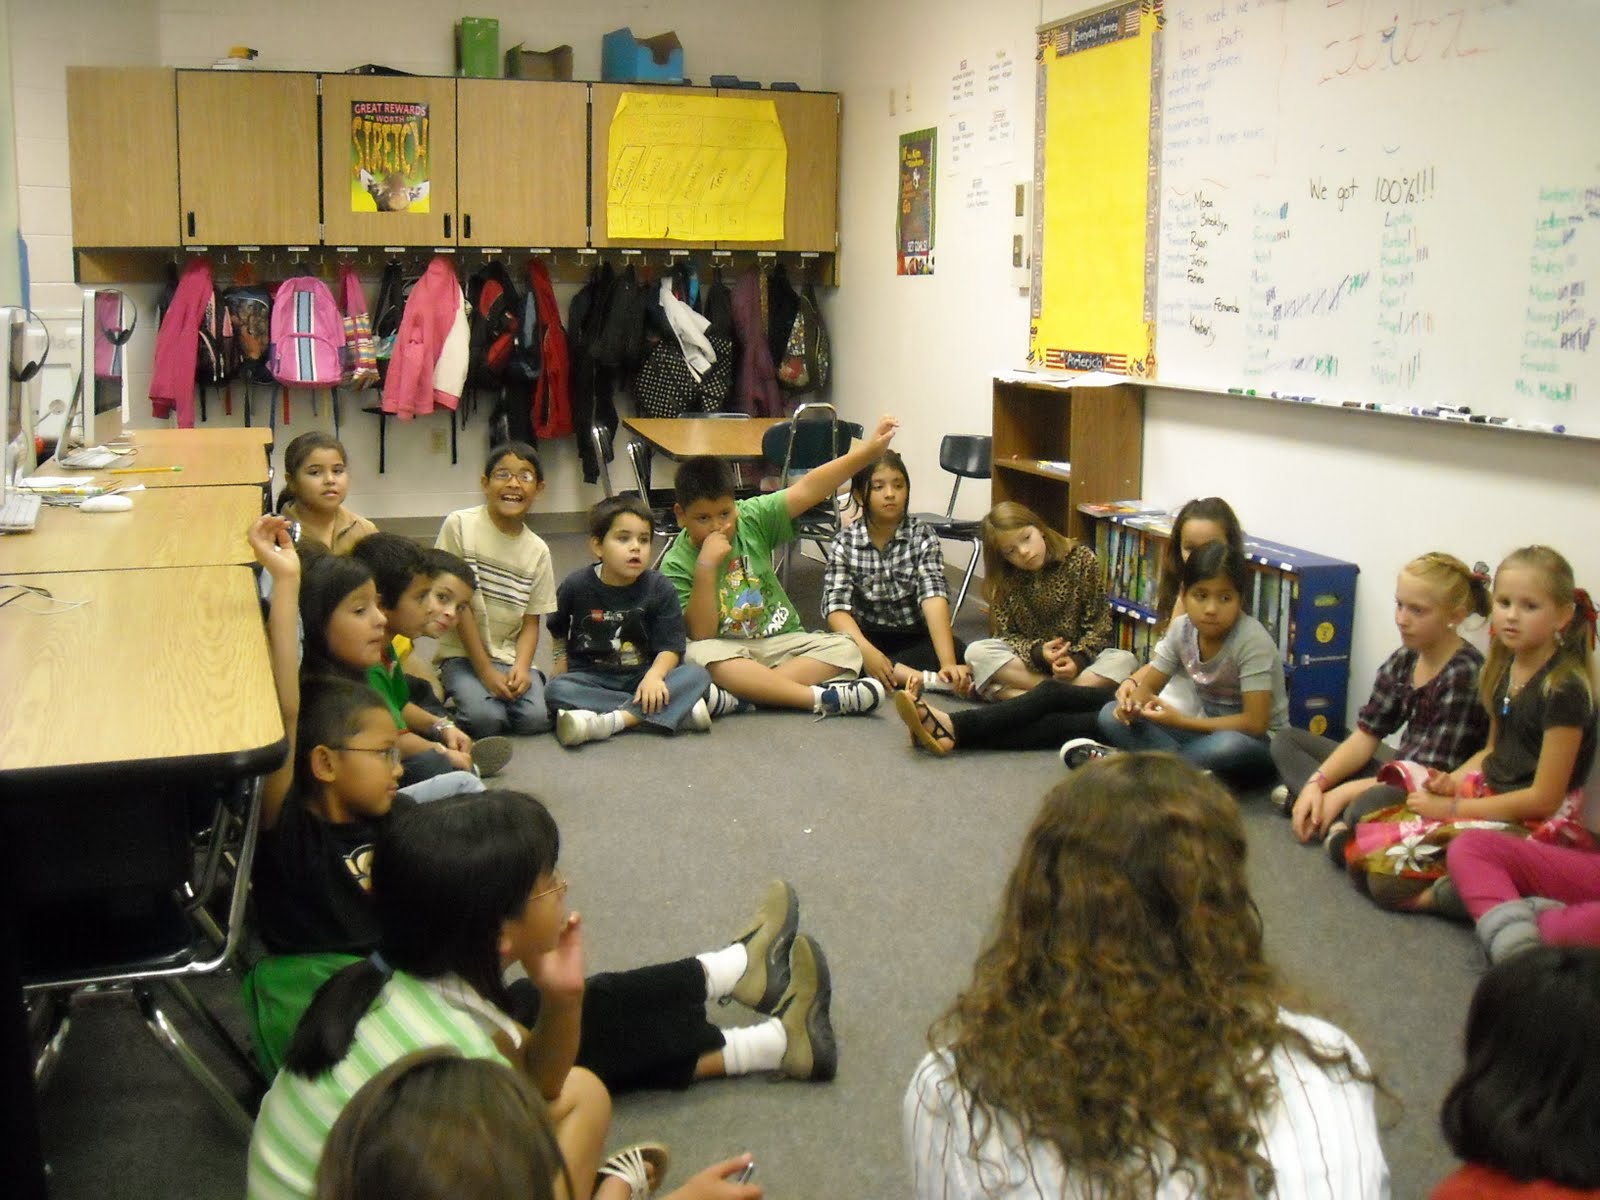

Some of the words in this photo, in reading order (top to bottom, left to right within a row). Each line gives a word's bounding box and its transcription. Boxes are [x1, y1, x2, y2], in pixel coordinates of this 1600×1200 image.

[1075, 27, 1097, 42] Everyday
[1099, 23, 1118, 35] Heroes
[354, 103, 383, 114] GREAT
[384, 103, 427, 116] REWARDS
[376, 115, 405, 123] WORTH
[352, 117, 428, 179] STRETCH
[1309, 176, 1327, 200] We
[1337, 177, 1359, 212] got
[1375, 165, 1434, 204] 100%!!!
[1200, 212, 1229, 236] Brooklyn
[1190, 230, 1208, 251] Ryan
[1189, 254, 1208, 268] Justin
[1214, 296, 1240, 314] Fernando
[1189, 312, 1216, 347] Kimberly
[1066, 353, 1103, 369] America
